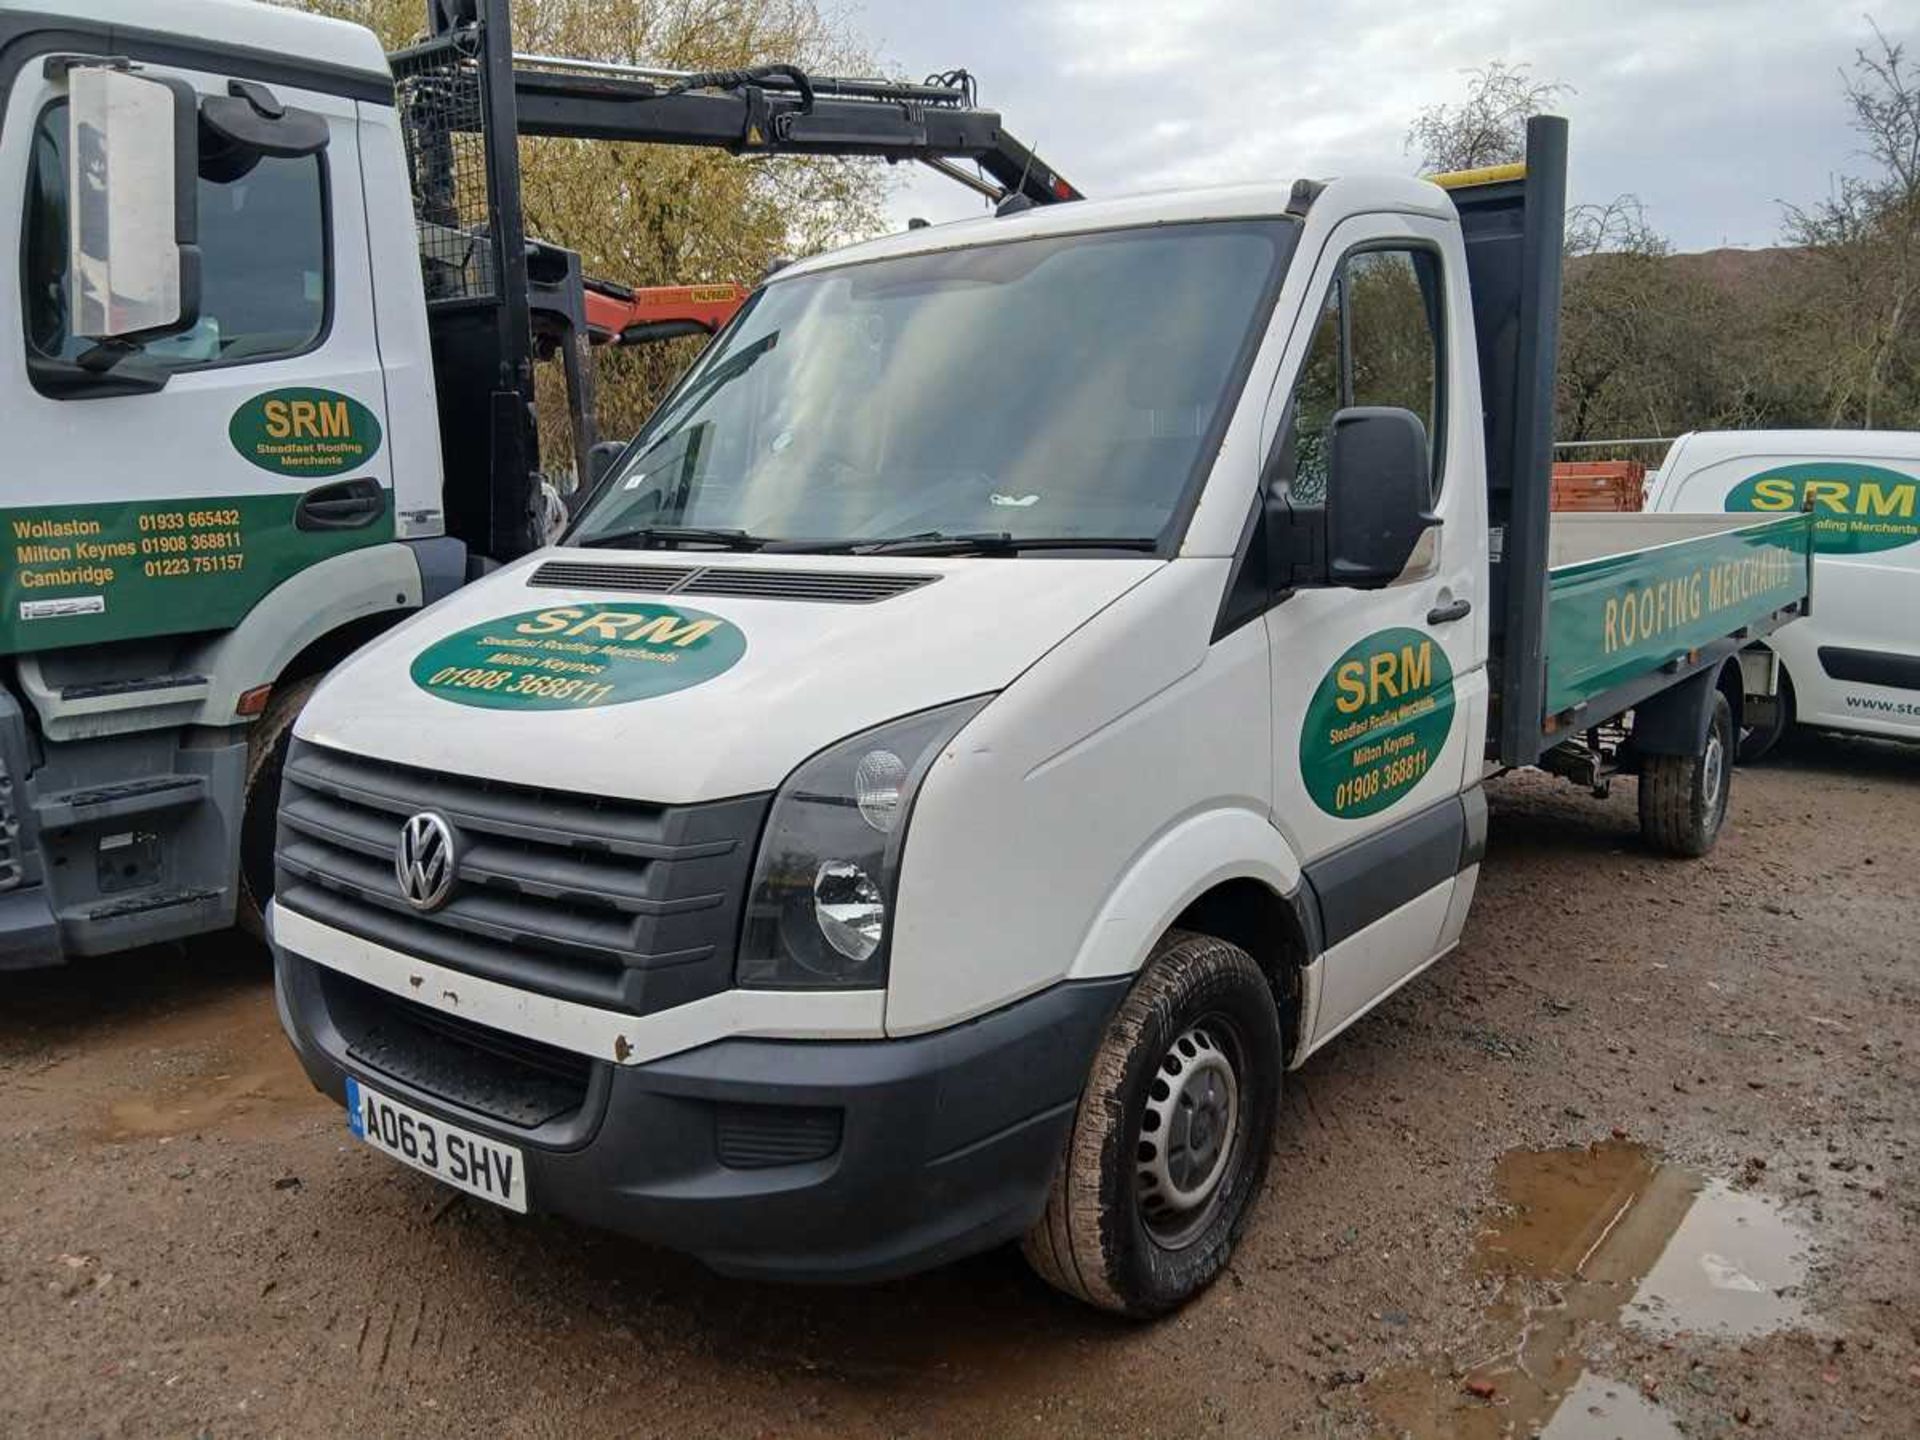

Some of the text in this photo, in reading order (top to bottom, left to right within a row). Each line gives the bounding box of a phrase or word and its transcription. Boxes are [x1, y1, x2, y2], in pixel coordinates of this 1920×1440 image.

[264, 399, 350, 438] SRM
[257, 442, 362, 454] Steadfast Roofing
[281, 455, 342, 466] Merchants
[1751, 479, 1916, 517] SRM
[13, 509, 241, 538] Wollaston 01933 665432
[1816, 519, 1918, 535] ofing Merchants
[17, 531, 241, 564] Milton Keynes 01908 368811
[20, 553, 244, 588] Cambridge 01223 751157
[1605, 548, 1792, 654] ROOFING MERCHANTS
[518, 608, 722, 647] SRM
[428, 666, 615, 705] 01908 368811
[1336, 641, 1432, 713] SRM
[1336, 747, 1427, 810] 01908 368811
[367, 1095, 513, 1200] AO63 SHV
